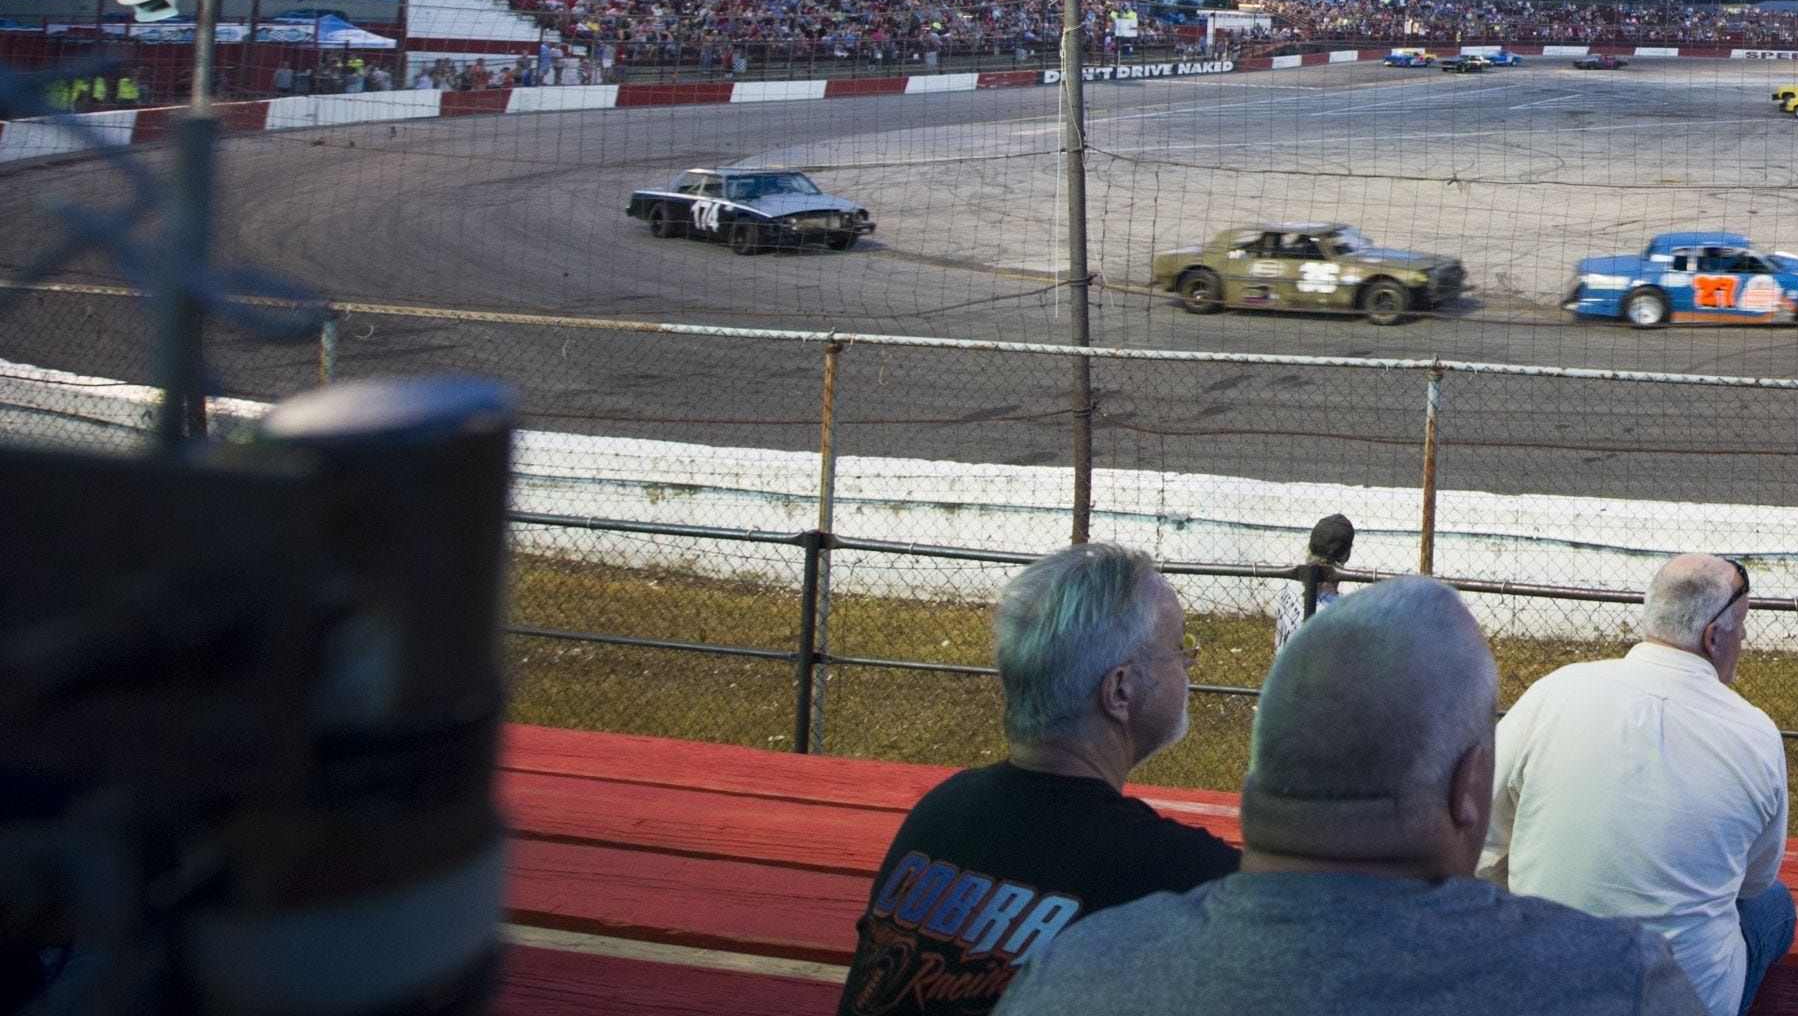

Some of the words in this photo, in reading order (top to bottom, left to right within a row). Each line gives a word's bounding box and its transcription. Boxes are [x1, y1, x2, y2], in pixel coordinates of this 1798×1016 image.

[1043, 67, 1113, 84] DN'T
[1116, 63, 1174, 79] DRIVE
[1177, 60, 1234, 75] NAKED
[872, 851, 1083, 968] COBRA
